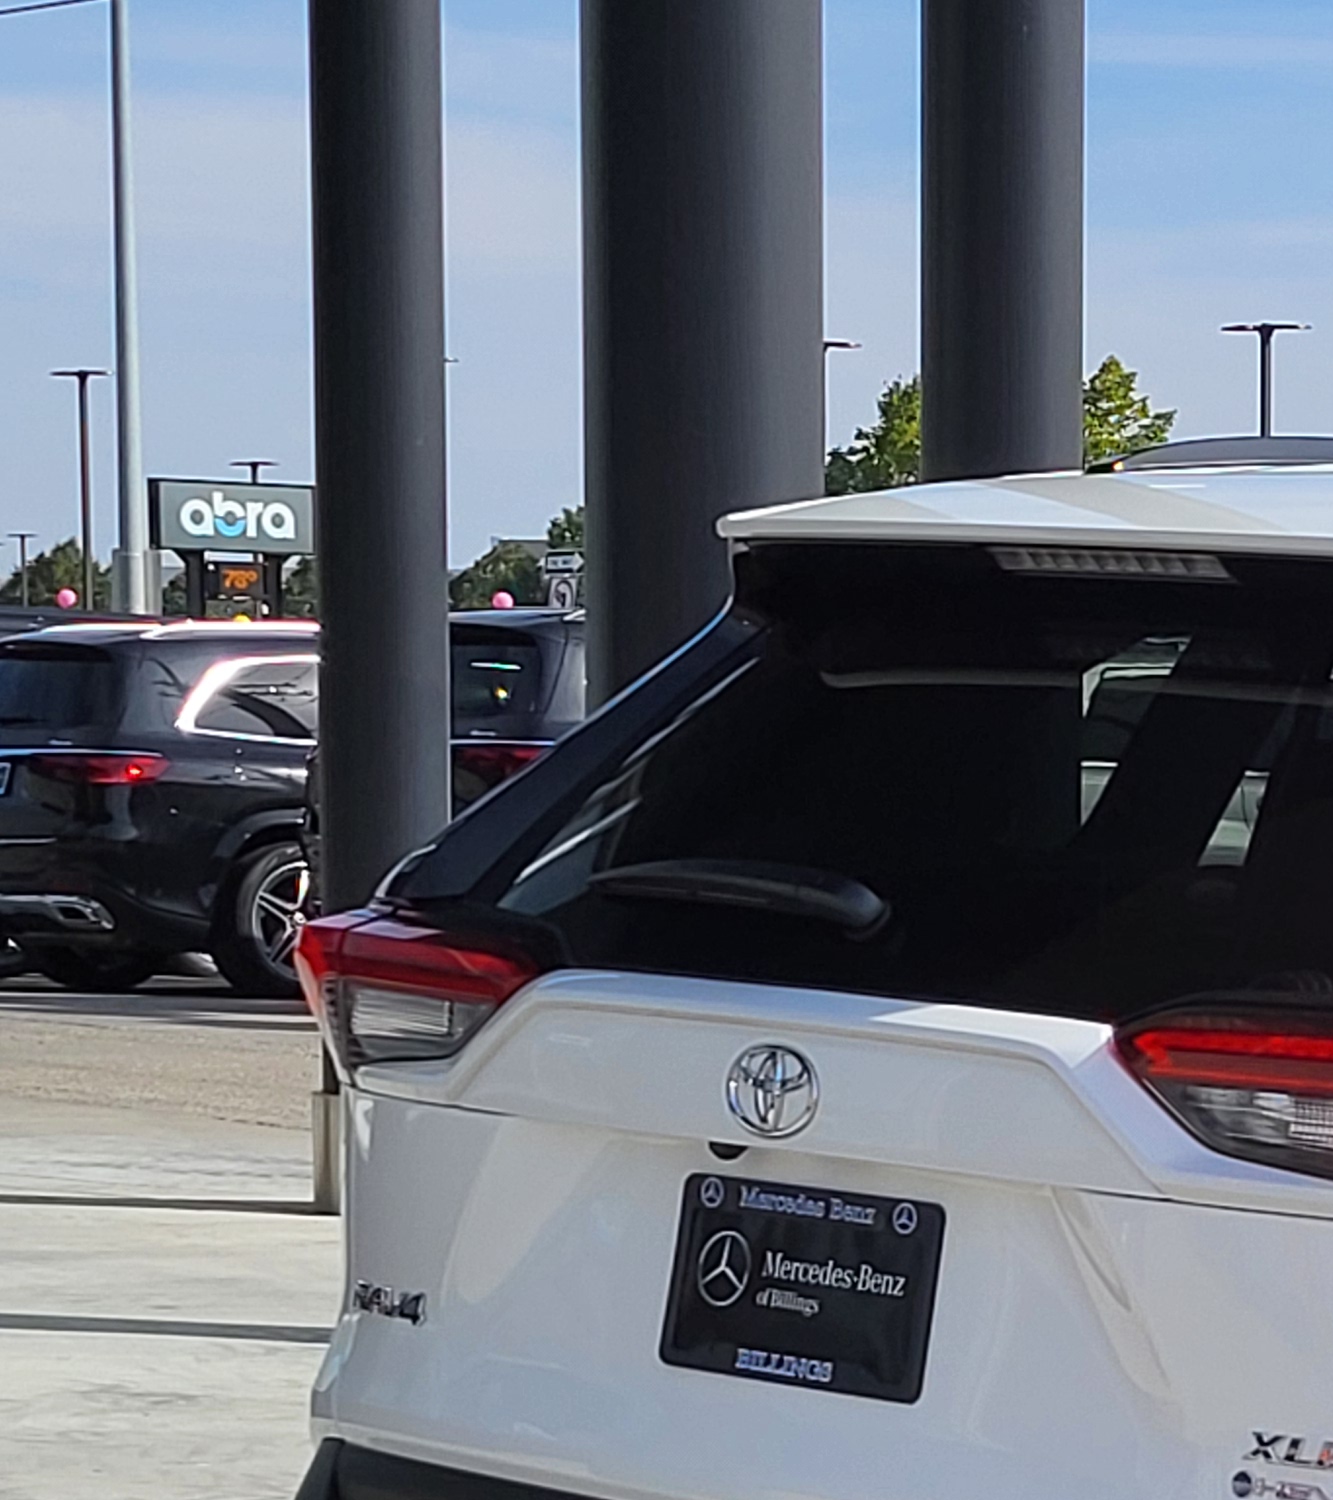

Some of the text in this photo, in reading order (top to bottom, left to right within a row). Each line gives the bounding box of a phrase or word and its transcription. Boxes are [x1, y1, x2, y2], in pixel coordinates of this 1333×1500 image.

[179, 491, 296, 539] abra
[761, 1250, 907, 1297] Mercedes-Benz
[735, 1348, 834, 1383] BILLINGS
